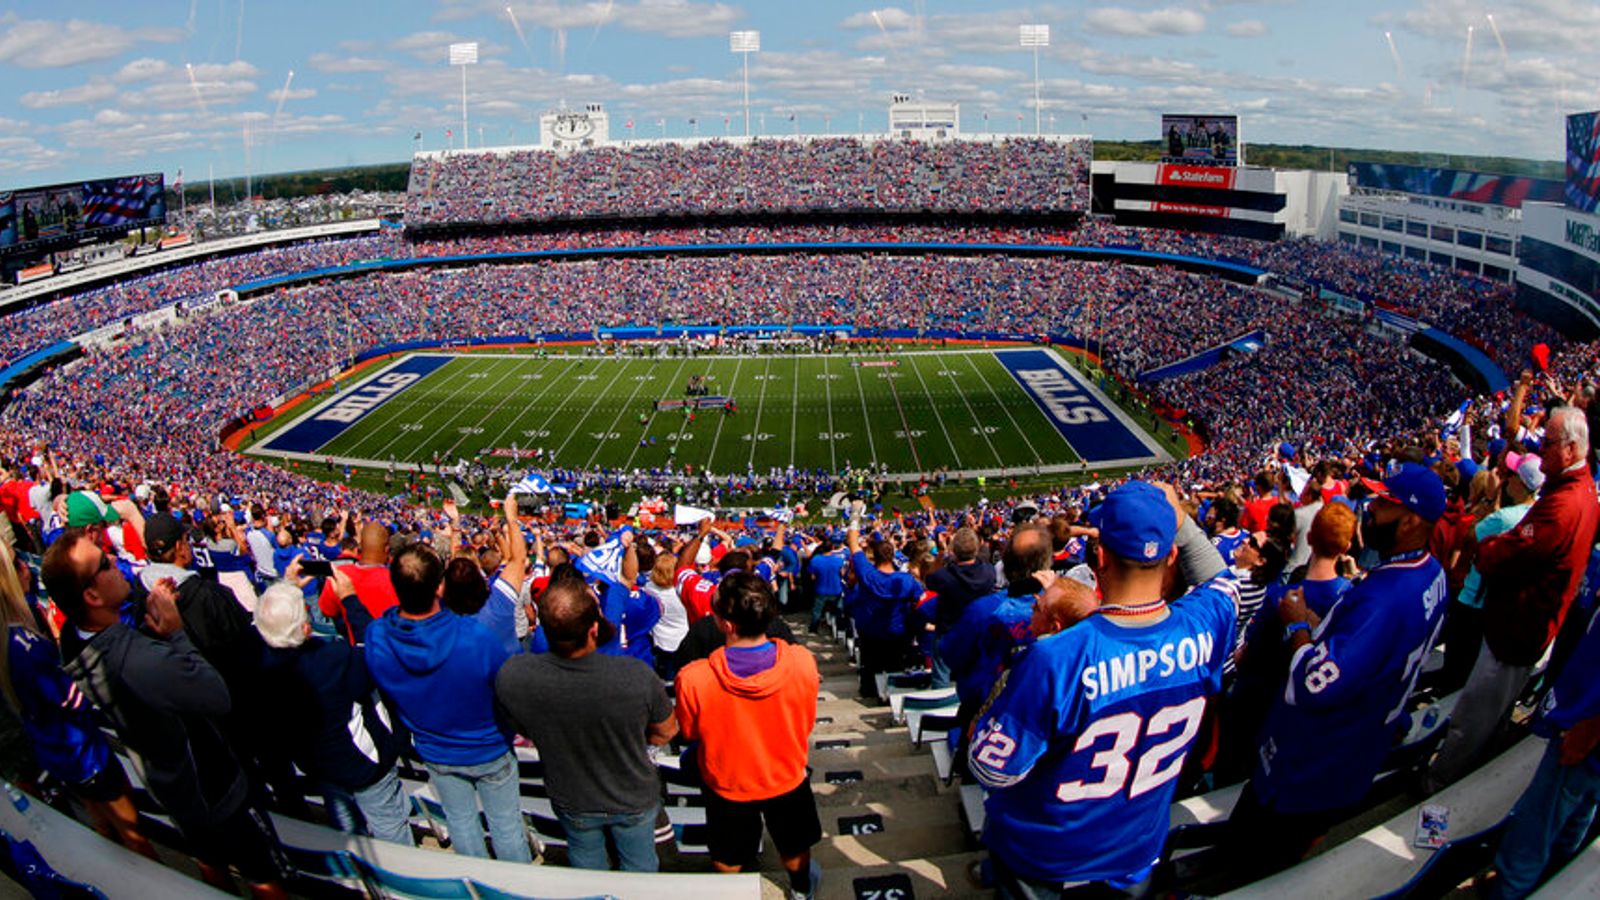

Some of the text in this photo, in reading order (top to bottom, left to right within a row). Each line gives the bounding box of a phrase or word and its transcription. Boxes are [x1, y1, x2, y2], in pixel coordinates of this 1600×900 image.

[314, 372, 421, 423] BILLS
[1016, 368, 1110, 424] BILLS
[193, 547, 215, 568] 51
[1082, 631, 1214, 701] SIMPSON
[1056, 695, 1207, 802] 32
